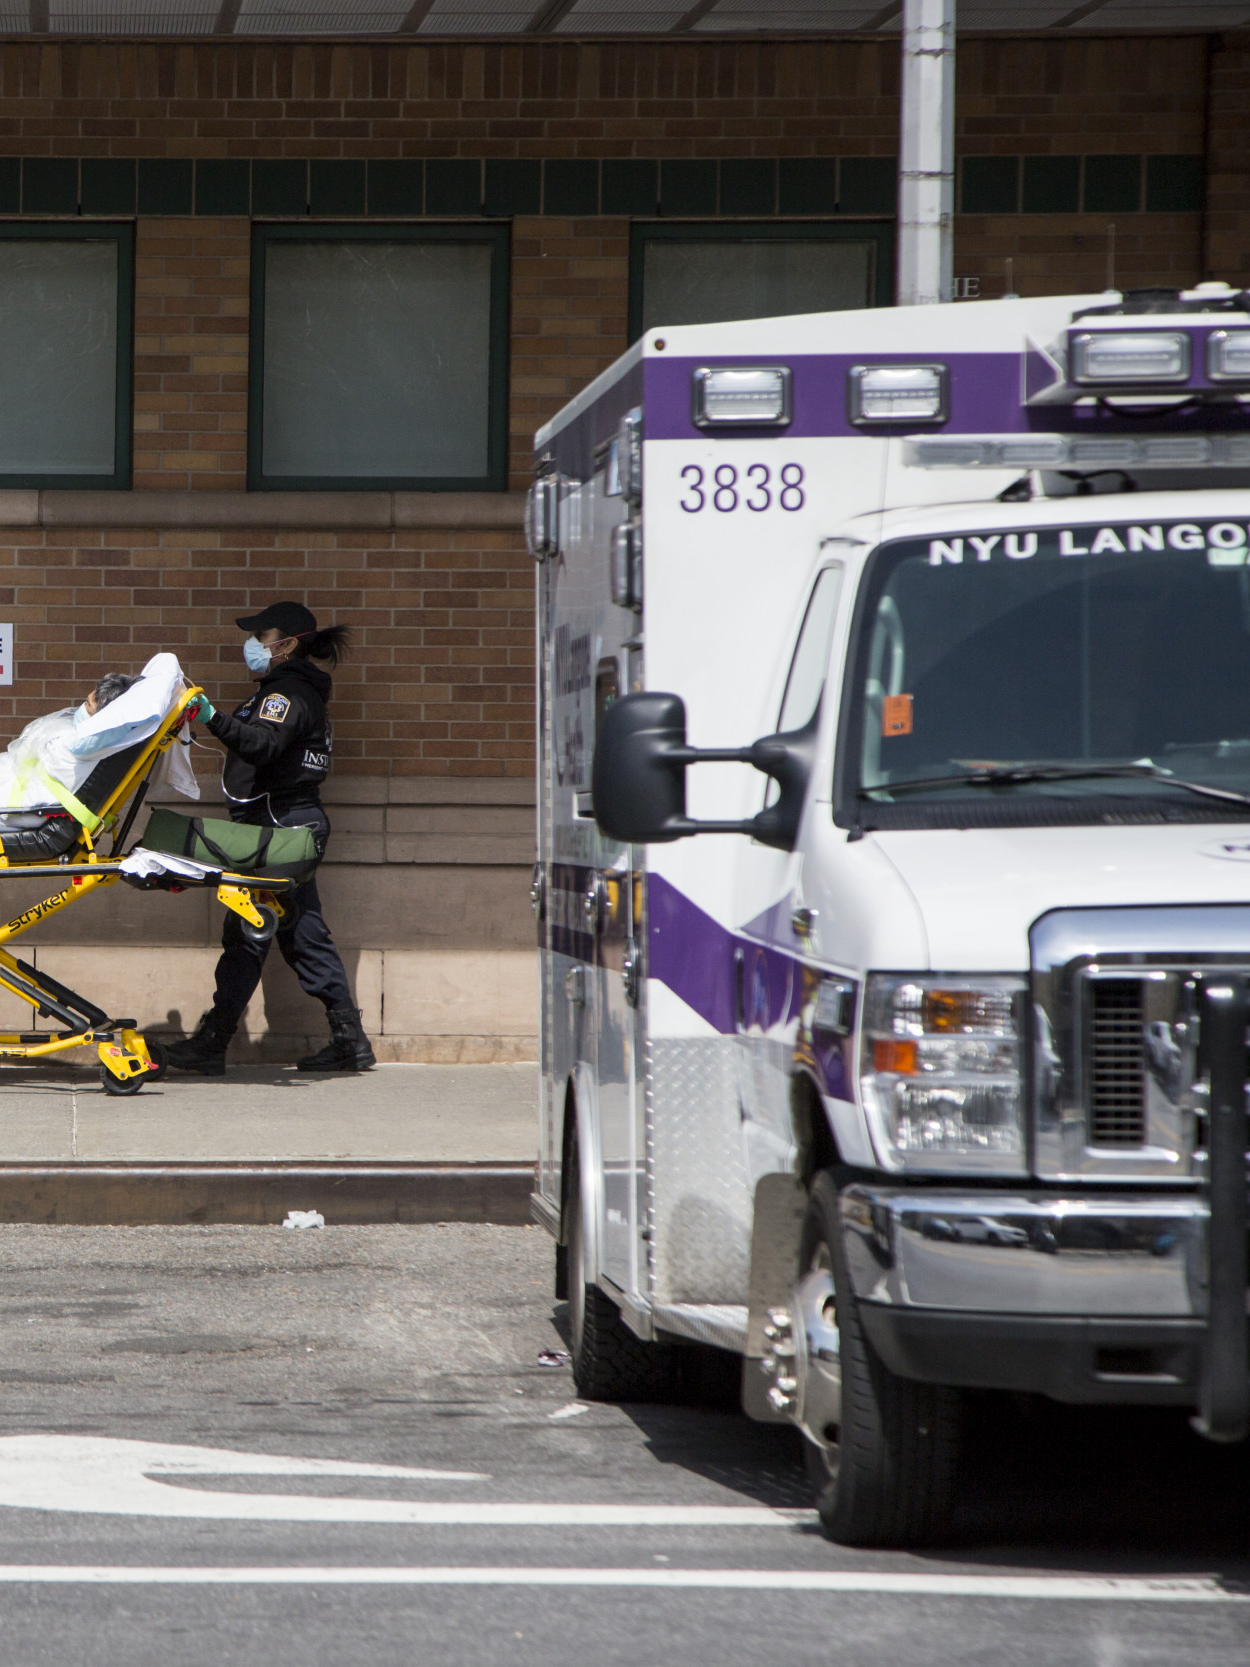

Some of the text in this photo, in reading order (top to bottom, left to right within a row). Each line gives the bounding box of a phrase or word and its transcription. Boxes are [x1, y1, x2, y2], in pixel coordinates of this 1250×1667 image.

[680, 462, 806, 513] 3838
[928, 522, 1250, 566] NYU LANGO
